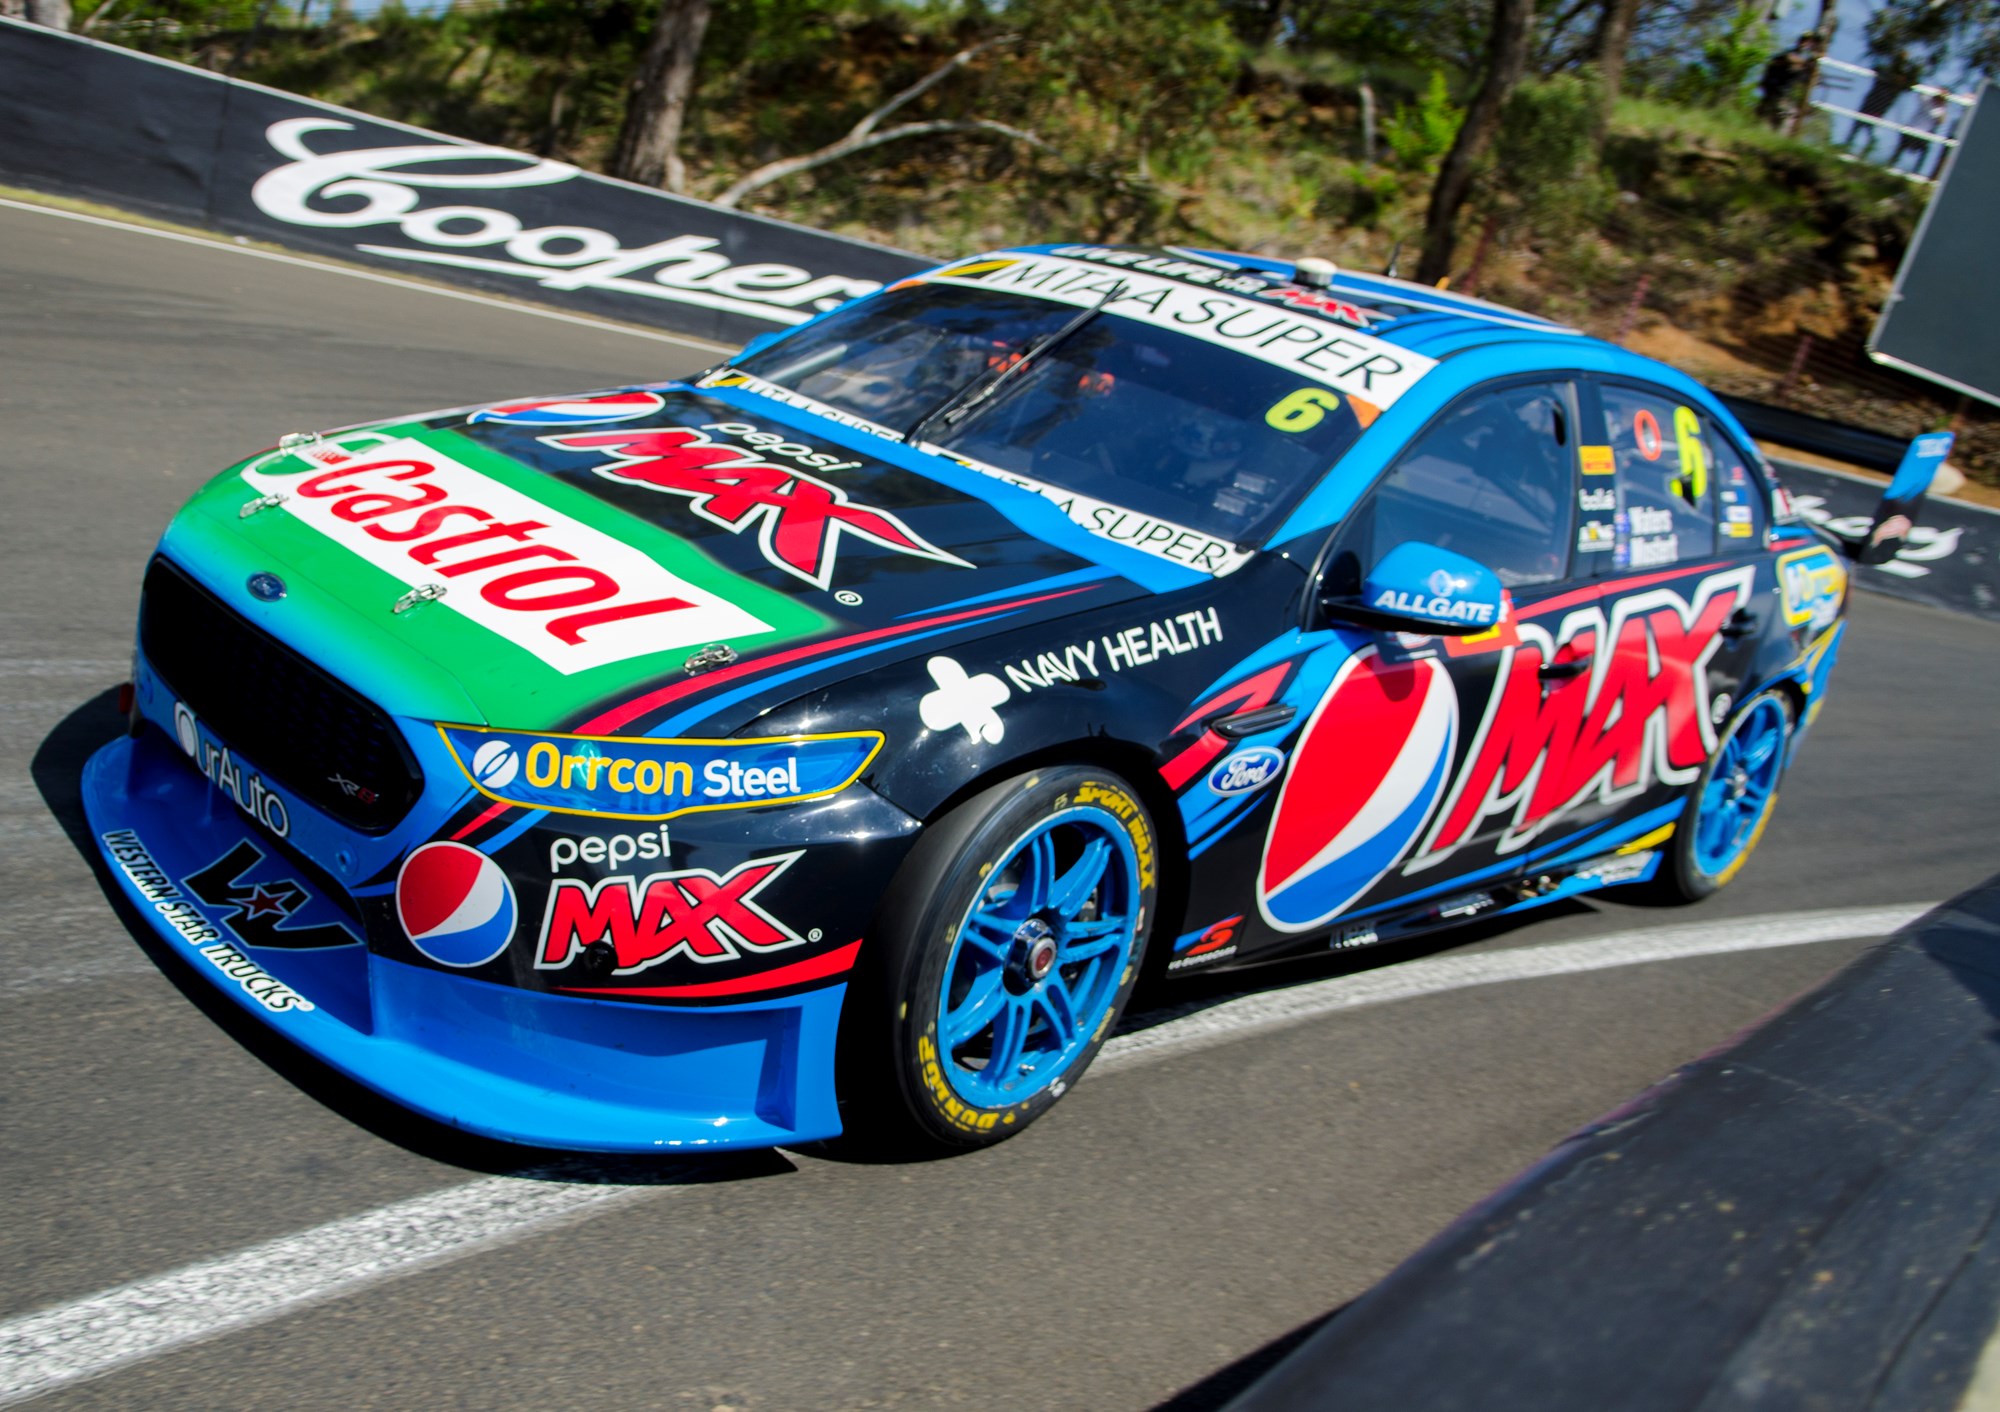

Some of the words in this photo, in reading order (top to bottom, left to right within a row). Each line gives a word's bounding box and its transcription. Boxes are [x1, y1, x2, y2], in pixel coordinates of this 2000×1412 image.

[988, 262, 1175, 315] MTAA
[1173, 297, 1402, 390] SUPER
[701, 422, 862, 472] pepsi
[1264, 387, 1340, 433] 6
[1670, 405, 1708, 499] 6
[296, 459, 702, 646] Castrol
[534, 427, 978, 592] MAX
[1004, 640, 1099, 692] NAVY
[1101, 606, 1223, 672] HEALTH
[1374, 590, 1495, 622] ALLGATE
[1402, 566, 1756, 876] MAX
[524, 741, 694, 797] Orrcon
[702, 757, 802, 797] Steel
[1221, 753, 1272, 790] Ford
[549, 823, 672, 874] pepsi
[102, 829, 184, 904] WESTERN
[153, 898, 220, 946] STAR
[199, 939, 302, 1013] TRUCKS
[533, 849, 808, 977] MAX
